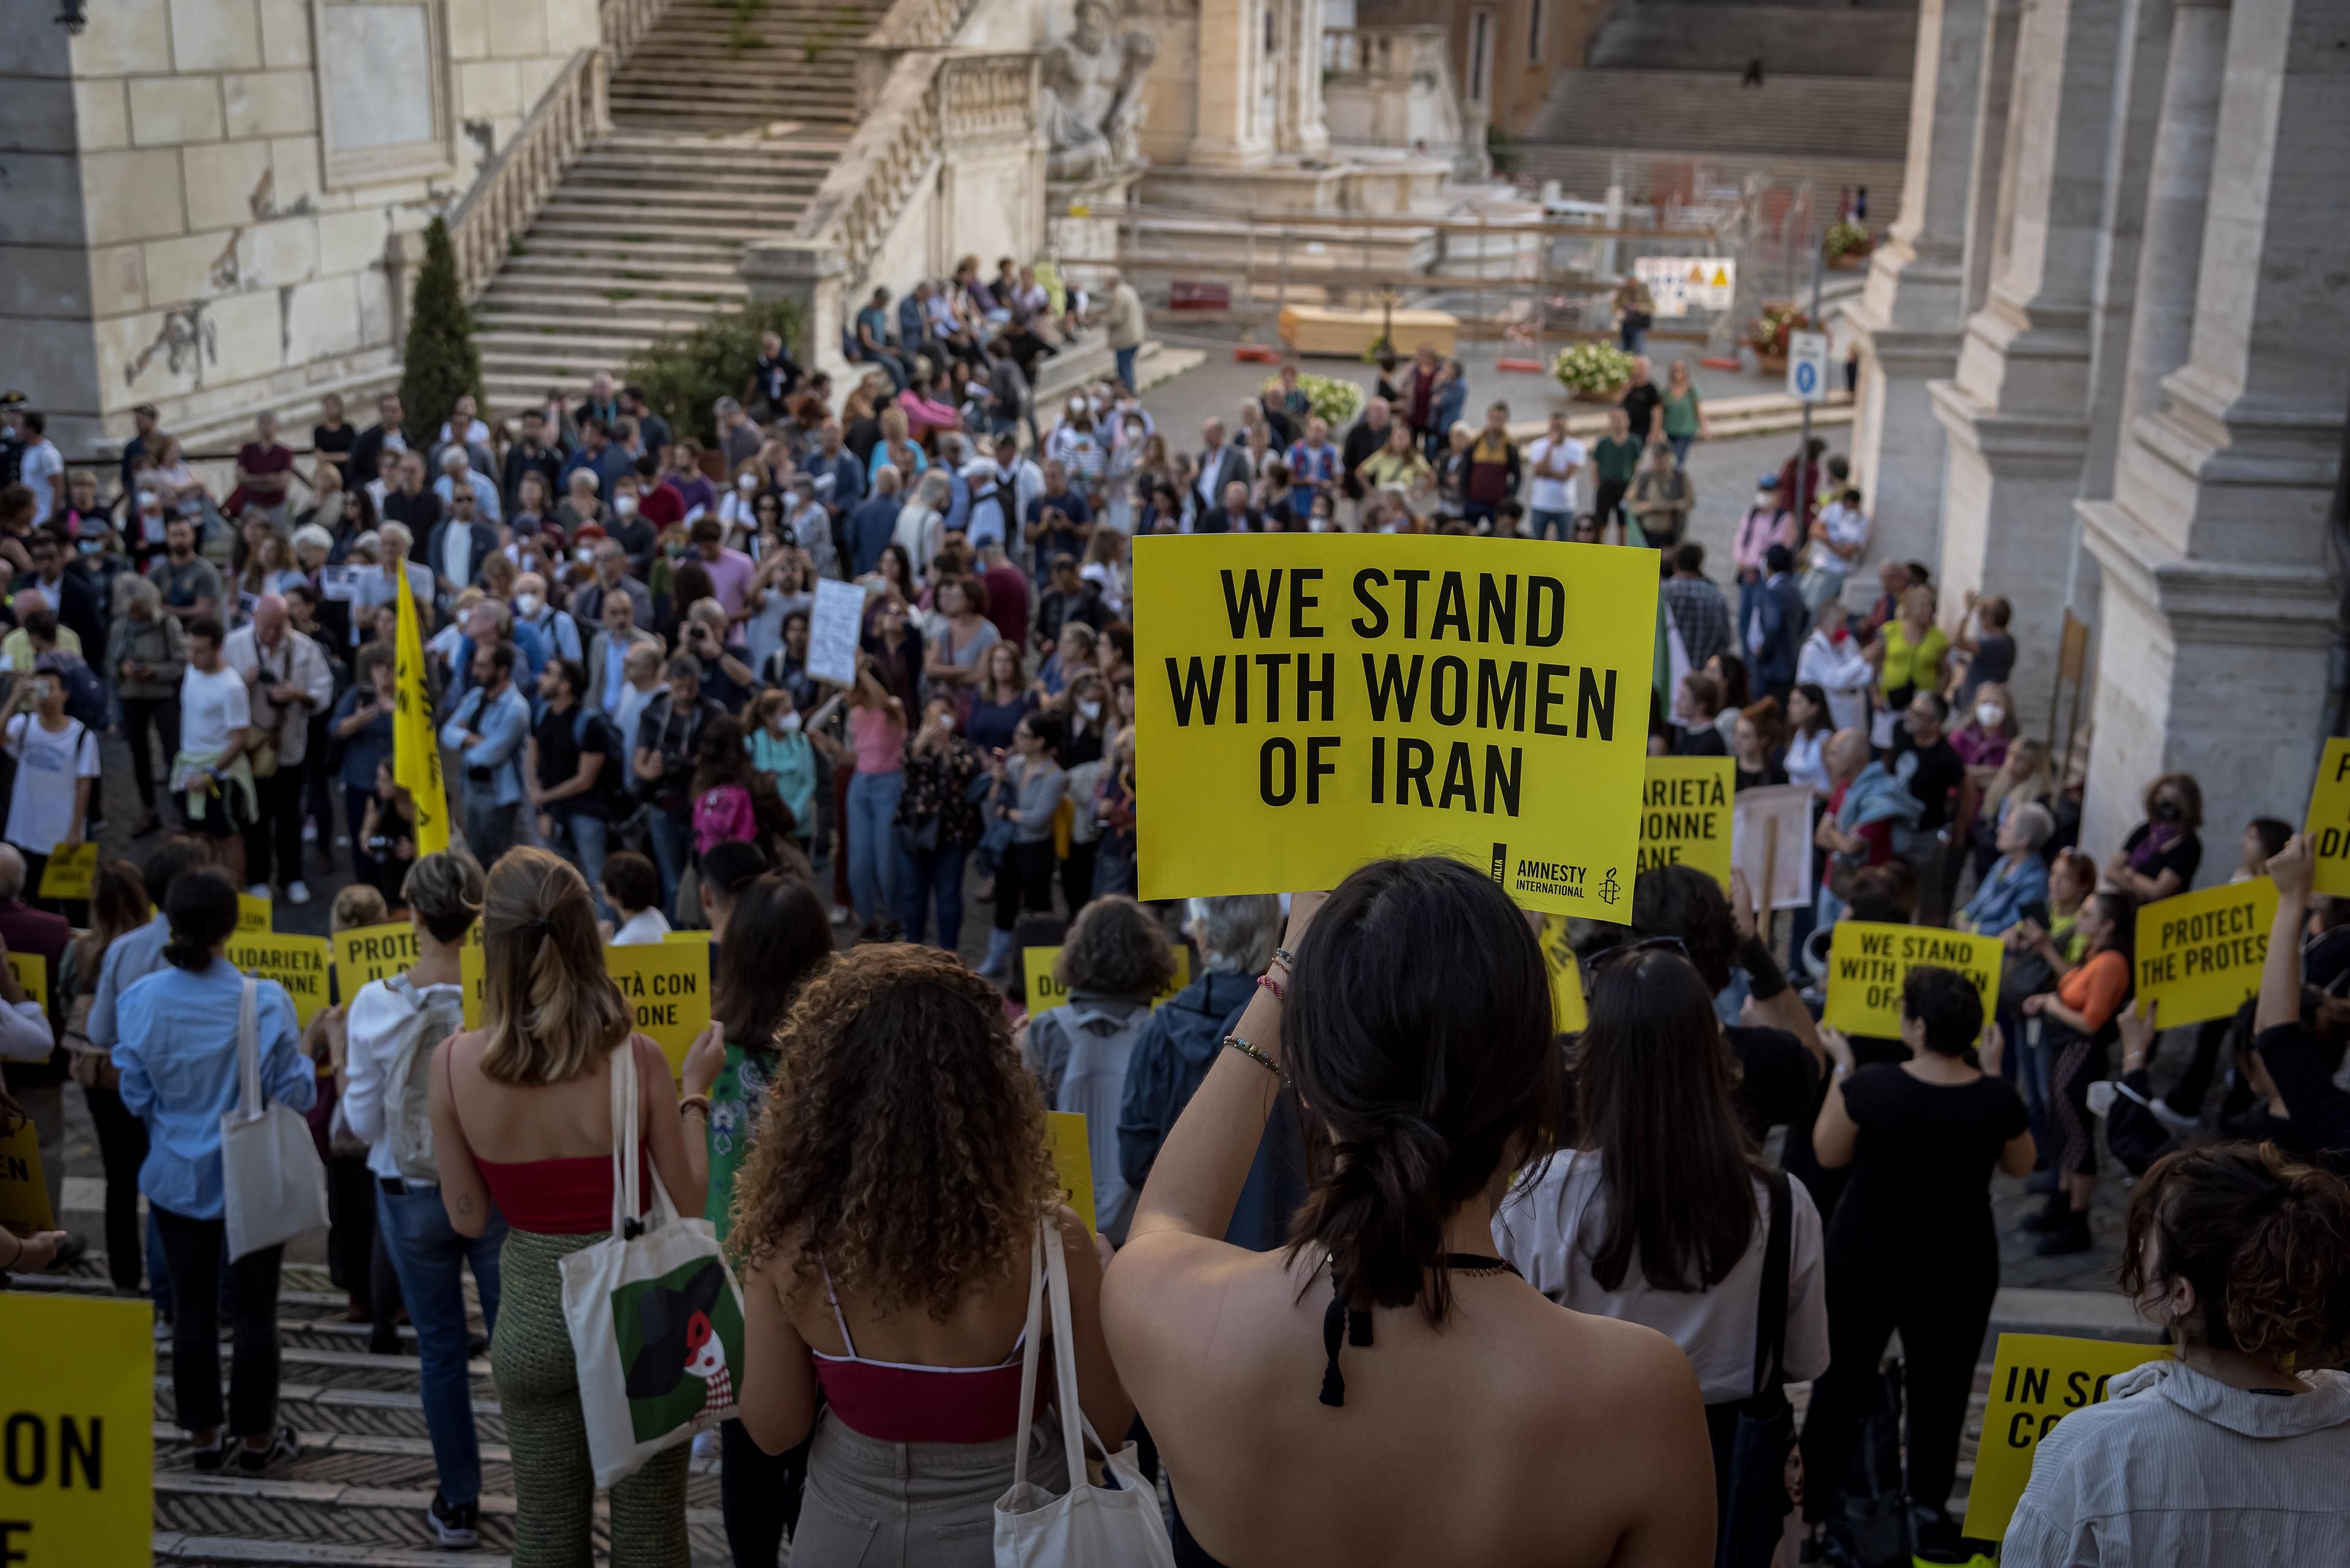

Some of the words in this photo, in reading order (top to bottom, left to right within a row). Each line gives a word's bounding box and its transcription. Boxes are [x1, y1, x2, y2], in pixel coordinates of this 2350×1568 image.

[1220, 568, 1324, 640] WE
[1351, 567, 1565, 647] STAND
[1165, 652, 1335, 727] WITH
[1362, 652, 1618, 741] WOMEN
[1259, 736, 1341, 807] OF
[1371, 736, 1523, 817] IRAN
[1493, 859, 1503, 883] ITALIA
[1517, 860, 1587, 884] AMNESTY
[1516, 879, 1584, 898] INTERNATIONAL
[2162, 902, 2255, 950] PROTECT
[1861, 934, 1895, 957] WE
[1901, 936, 1973, 963] STAND
[2141, 952, 2177, 987] THE
[2185, 934, 2268, 977] PROTES
[654, 973, 696, 995] CON
[1840, 957, 1896, 982] WITH
[1866, 985, 1895, 1009] OF
[637, 1003, 678, 1026] ONE
[2005, 1366, 2050, 1403] IN
[5, 1411, 102, 1491] ON
